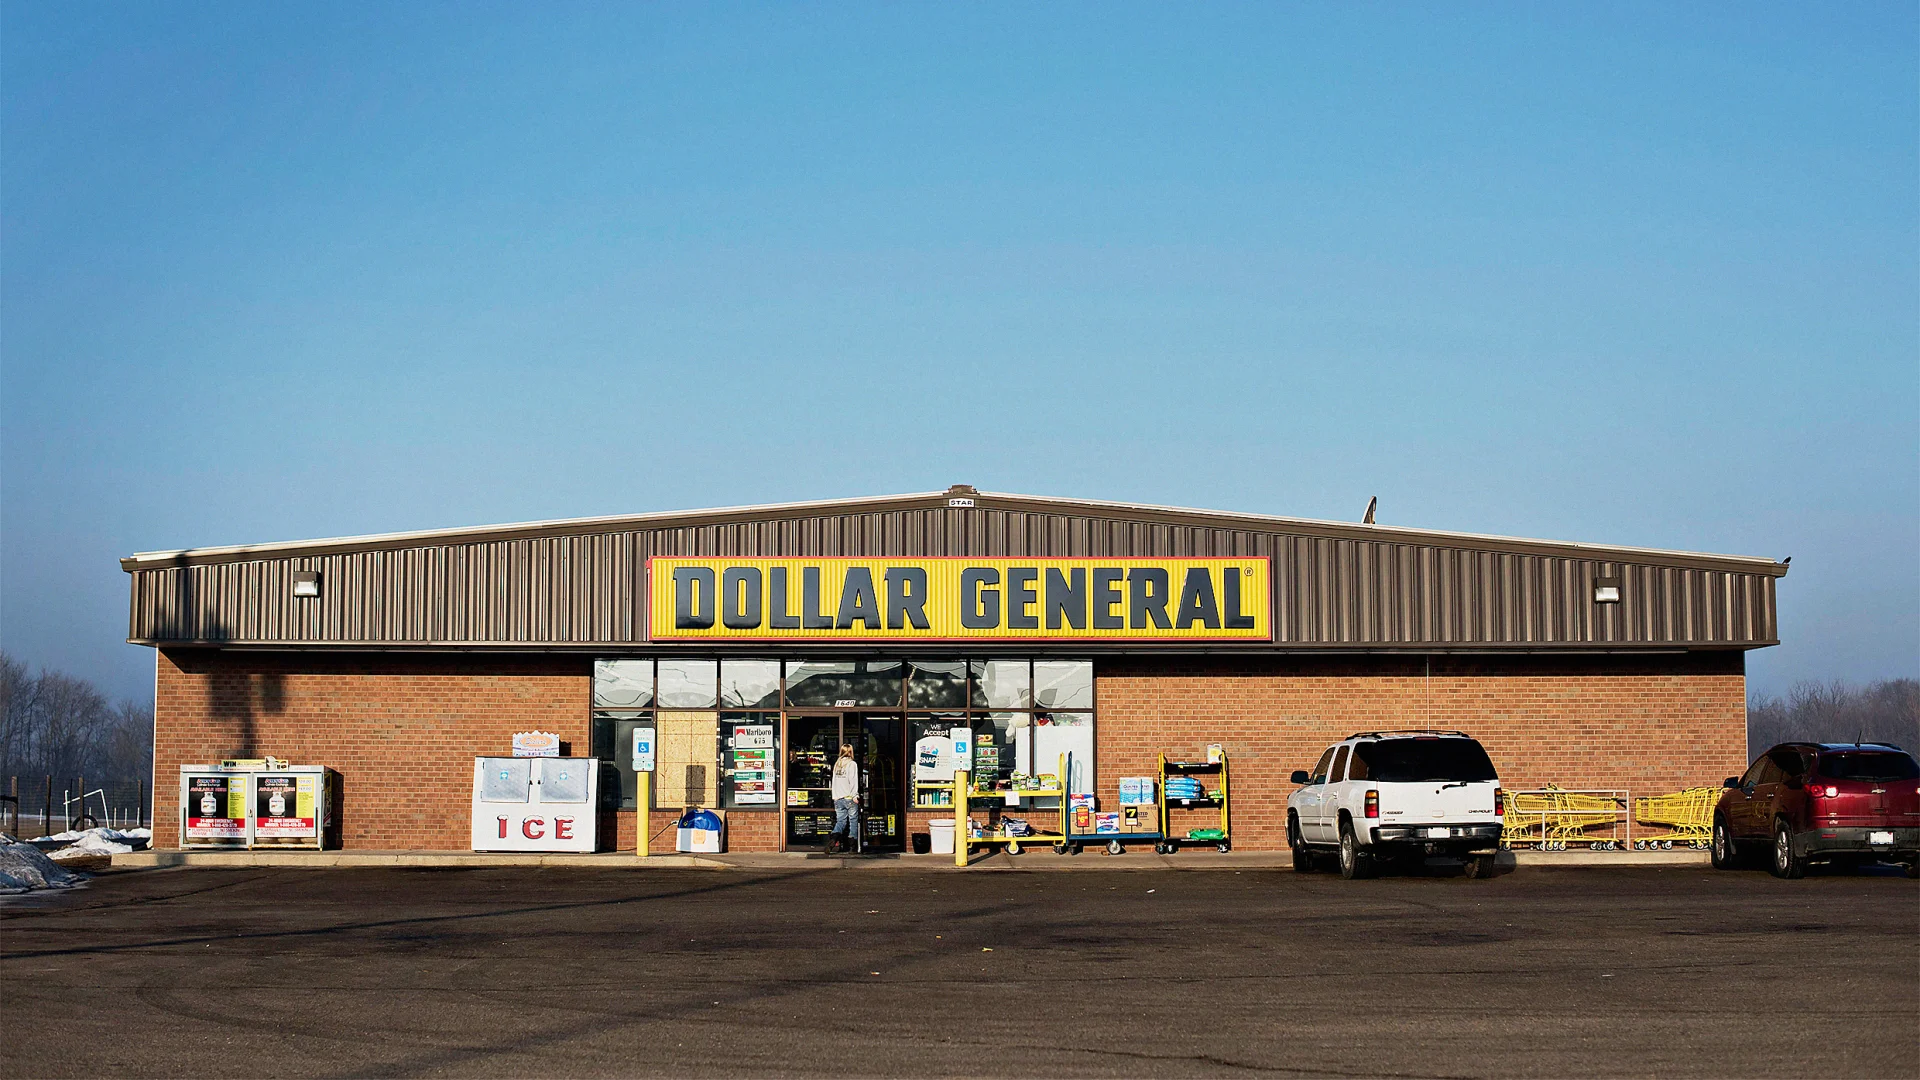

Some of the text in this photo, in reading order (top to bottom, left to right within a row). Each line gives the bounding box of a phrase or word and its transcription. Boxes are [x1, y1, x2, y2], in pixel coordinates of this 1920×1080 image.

[673, 566, 931, 630] DOLLAR
[961, 566, 1255, 630] GENERAL
[923, 729, 949, 738] Accept
[920, 756, 938, 764] SNAP
[497, 815, 575, 840] ICE
